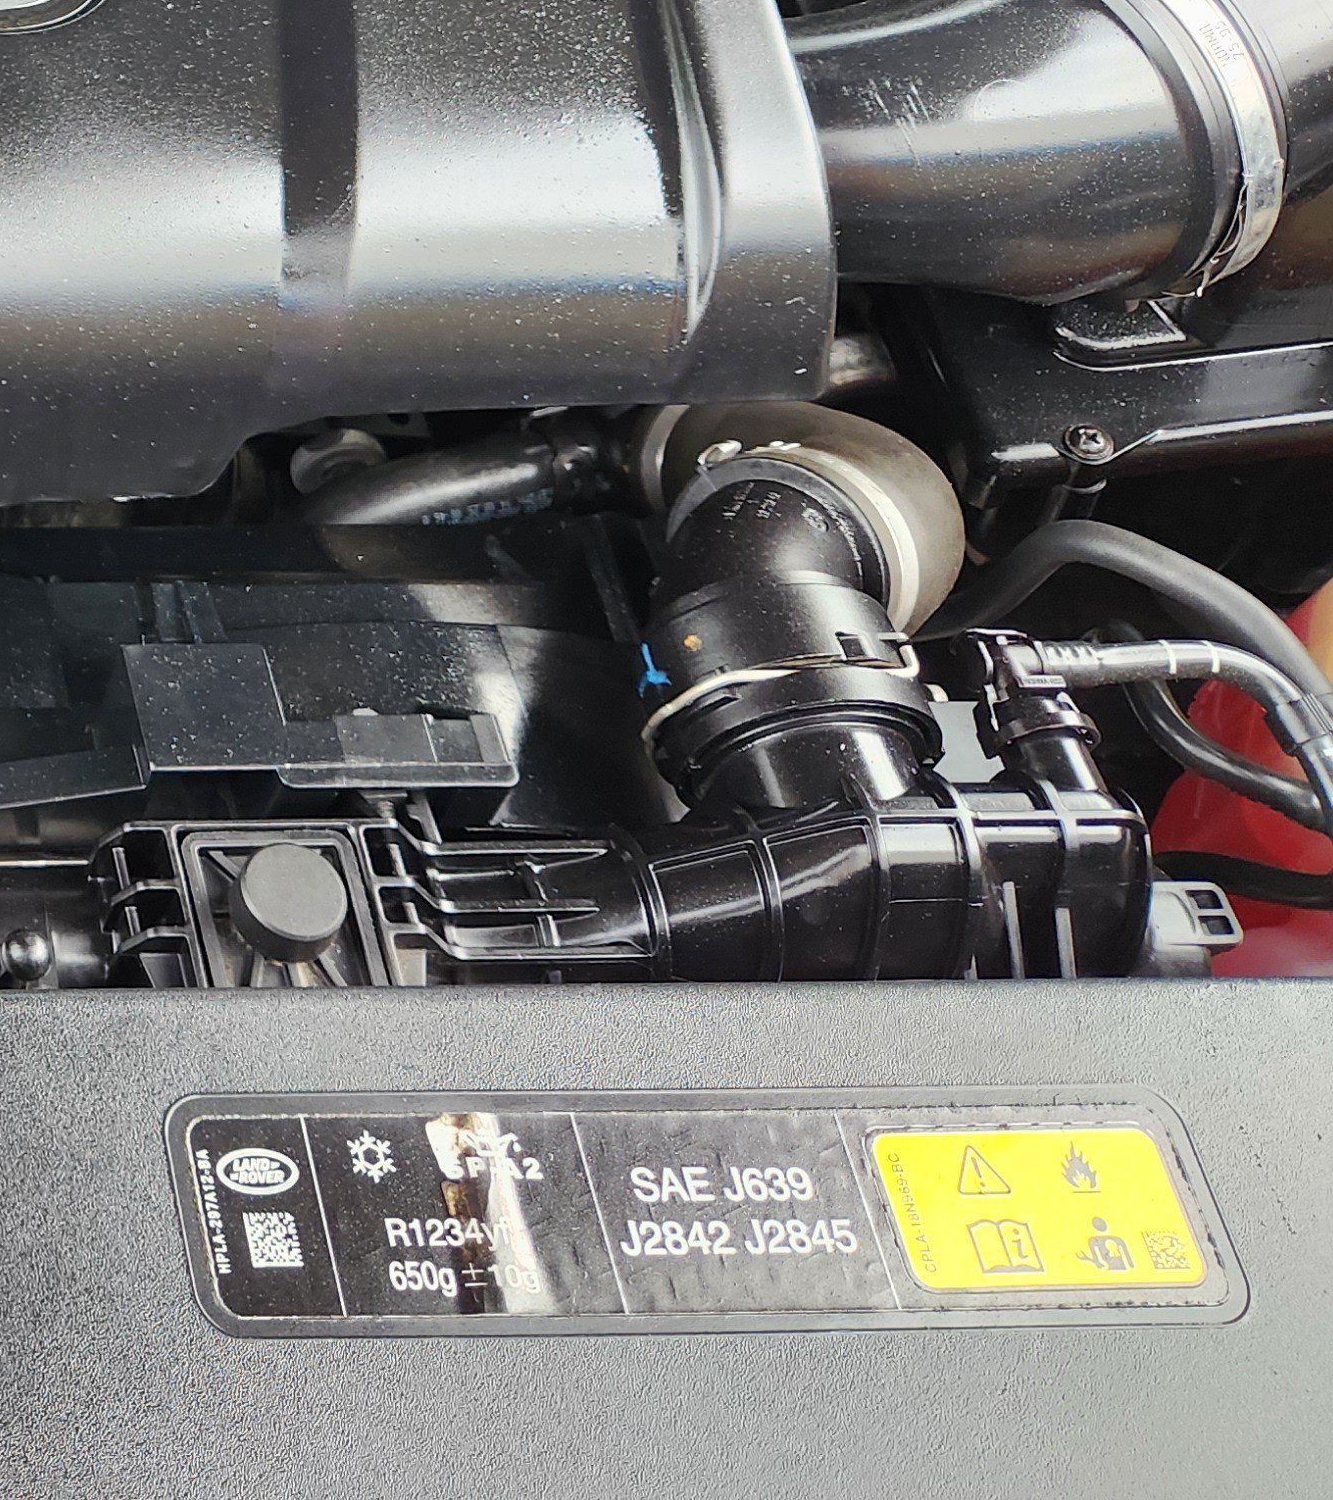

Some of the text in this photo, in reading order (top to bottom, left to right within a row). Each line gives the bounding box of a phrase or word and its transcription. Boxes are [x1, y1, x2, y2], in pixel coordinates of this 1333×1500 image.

[232, 1157, 271, 1172] LAND
[237, 1169, 286, 1185] ROVER
[630, 1166, 813, 1202] SAE J639
[195, 1148, 233, 1275] HPLA-297A12-BA
[384, 1217, 515, 1251] R1234yf
[619, 1218, 858, 1256] J2842 J2845
[388, 1260, 458, 1298] 650g
